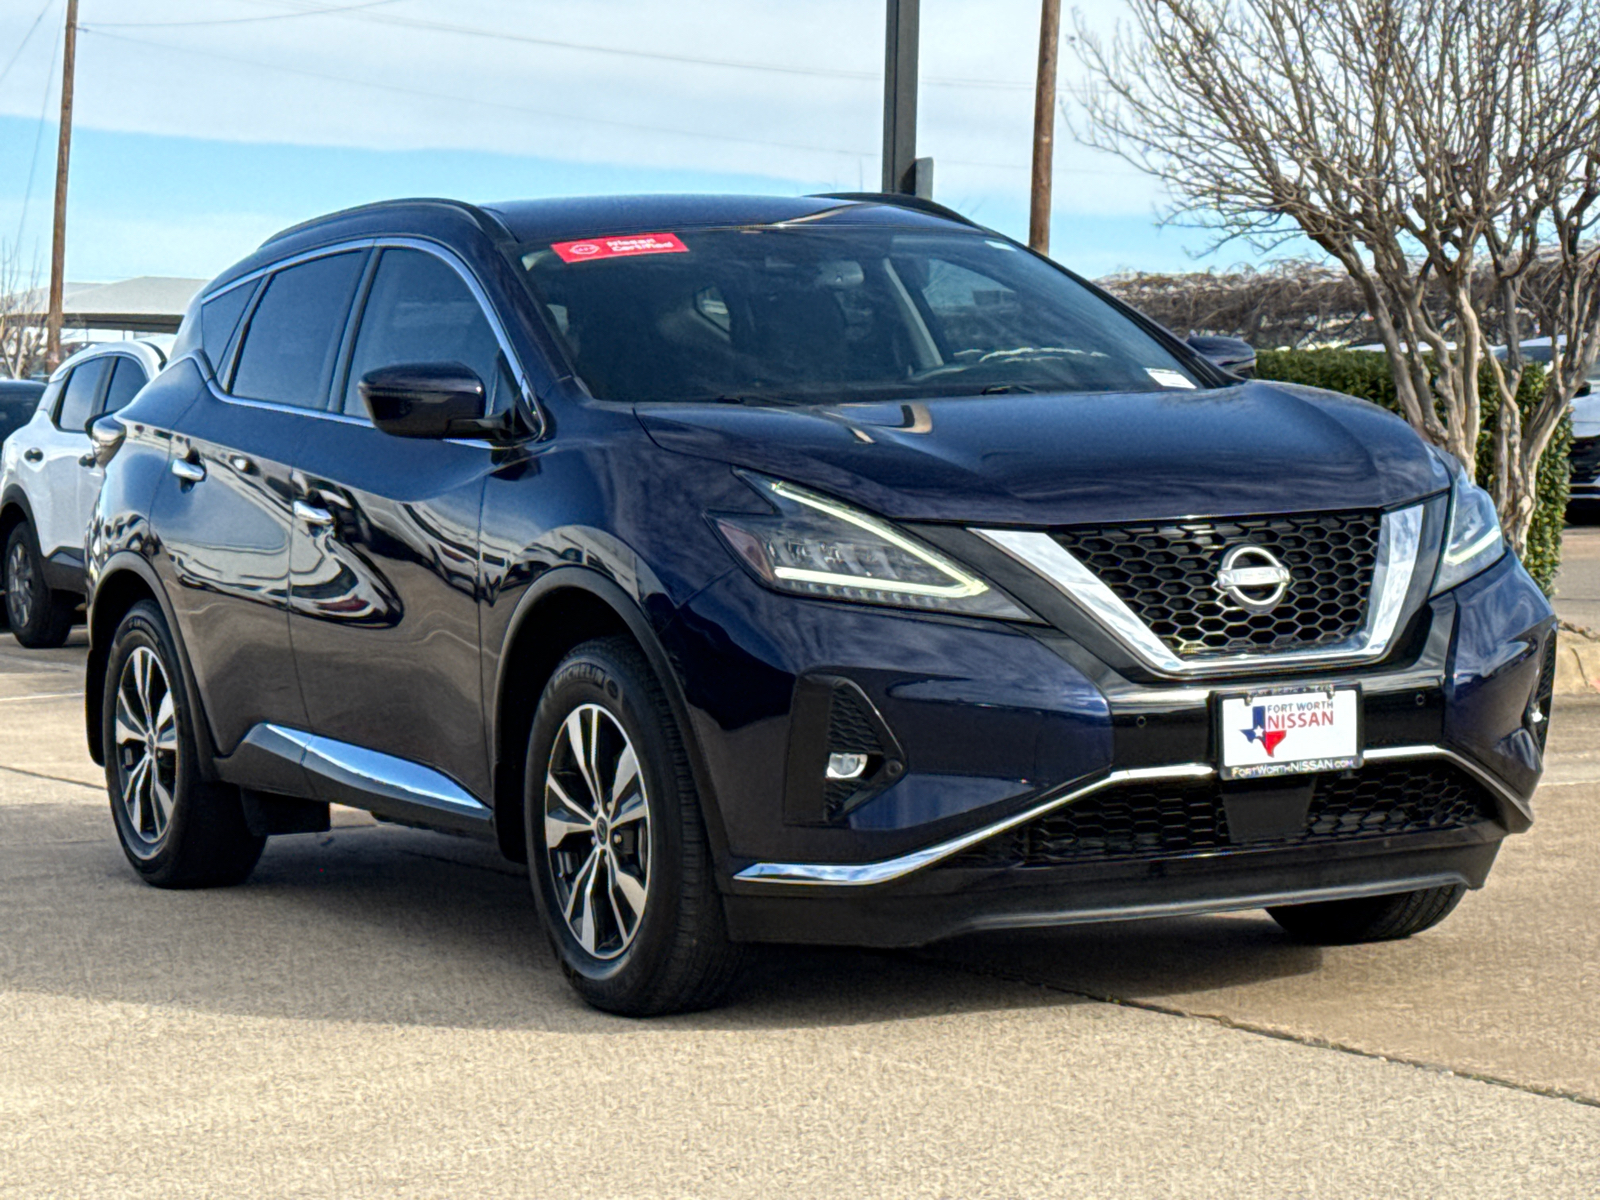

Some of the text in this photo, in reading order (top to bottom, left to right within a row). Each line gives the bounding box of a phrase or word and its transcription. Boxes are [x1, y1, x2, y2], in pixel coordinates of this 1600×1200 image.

[611, 241, 674, 252] Certified
[1267, 700, 1334, 713] FORT WORTH
[1267, 710, 1334, 730] NISSAN
